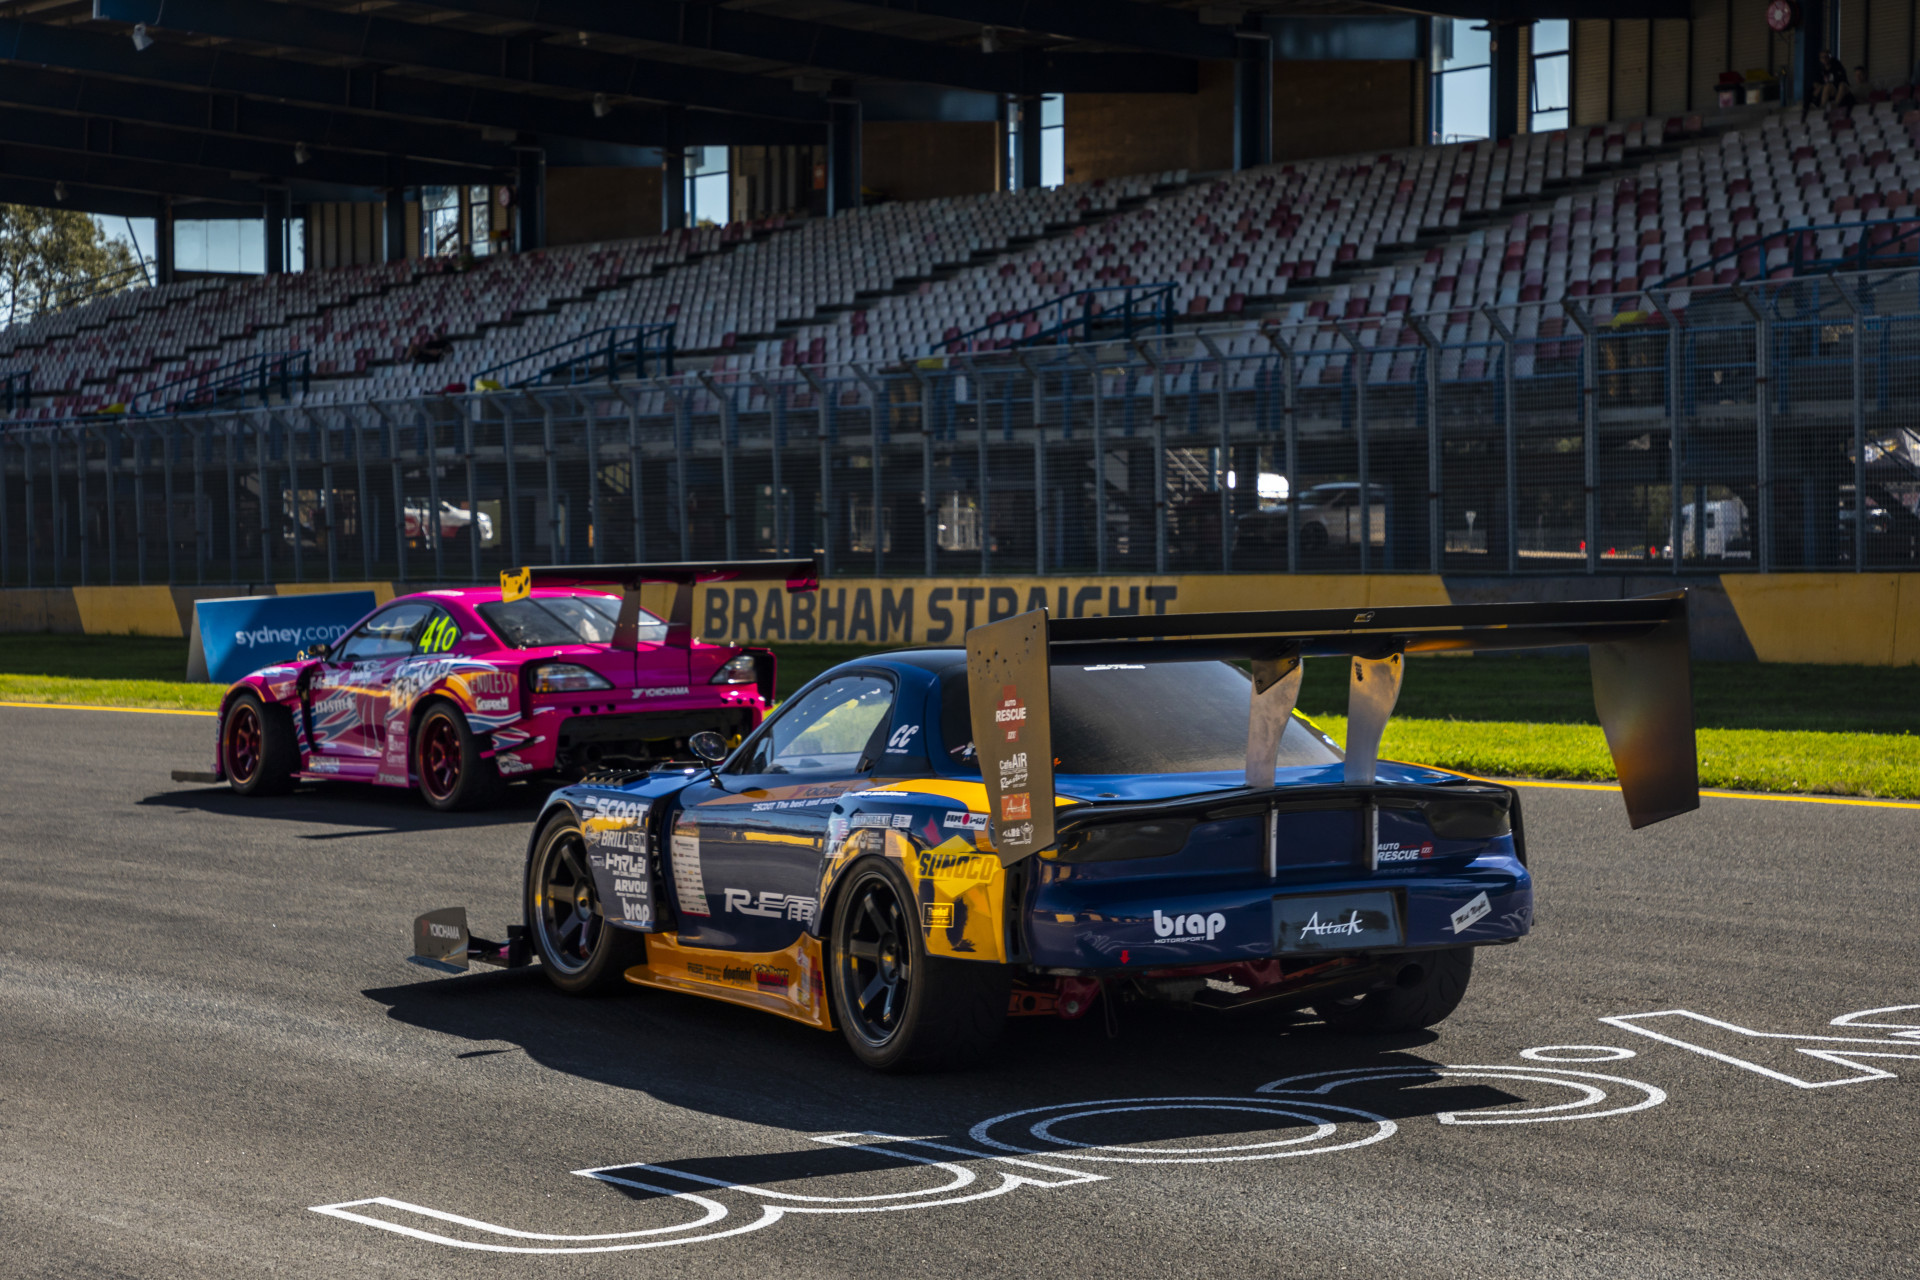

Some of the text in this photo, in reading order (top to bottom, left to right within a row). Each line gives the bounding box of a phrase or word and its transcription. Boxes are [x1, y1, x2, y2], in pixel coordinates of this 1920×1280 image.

[703, 587, 913, 642] BRABHAM
[236, 624, 348, 648] sydney.com
[419, 616, 457, 653] 410
[471, 671, 513, 693] ENDLESS
[645, 686, 690, 697] YOKOHAMA
[996, 707, 1026, 722] RESCUE
[595, 798, 649, 826] SCOOT
[776, 801, 789, 810] The
[789, 800, 806, 808] best
[806, 798, 820, 807] and
[1377, 850, 1420, 861] RESCUE
[1378, 843, 1400, 851] AUTO
[919, 853, 996, 881] SUNOCO
[614, 879, 648, 893] ARVOU
[622, 897, 650, 926] brap
[1153, 909, 1226, 941] brap
[1300, 910, 1364, 940] Attack
[1154, 935, 1206, 944] MOTORSPORT
